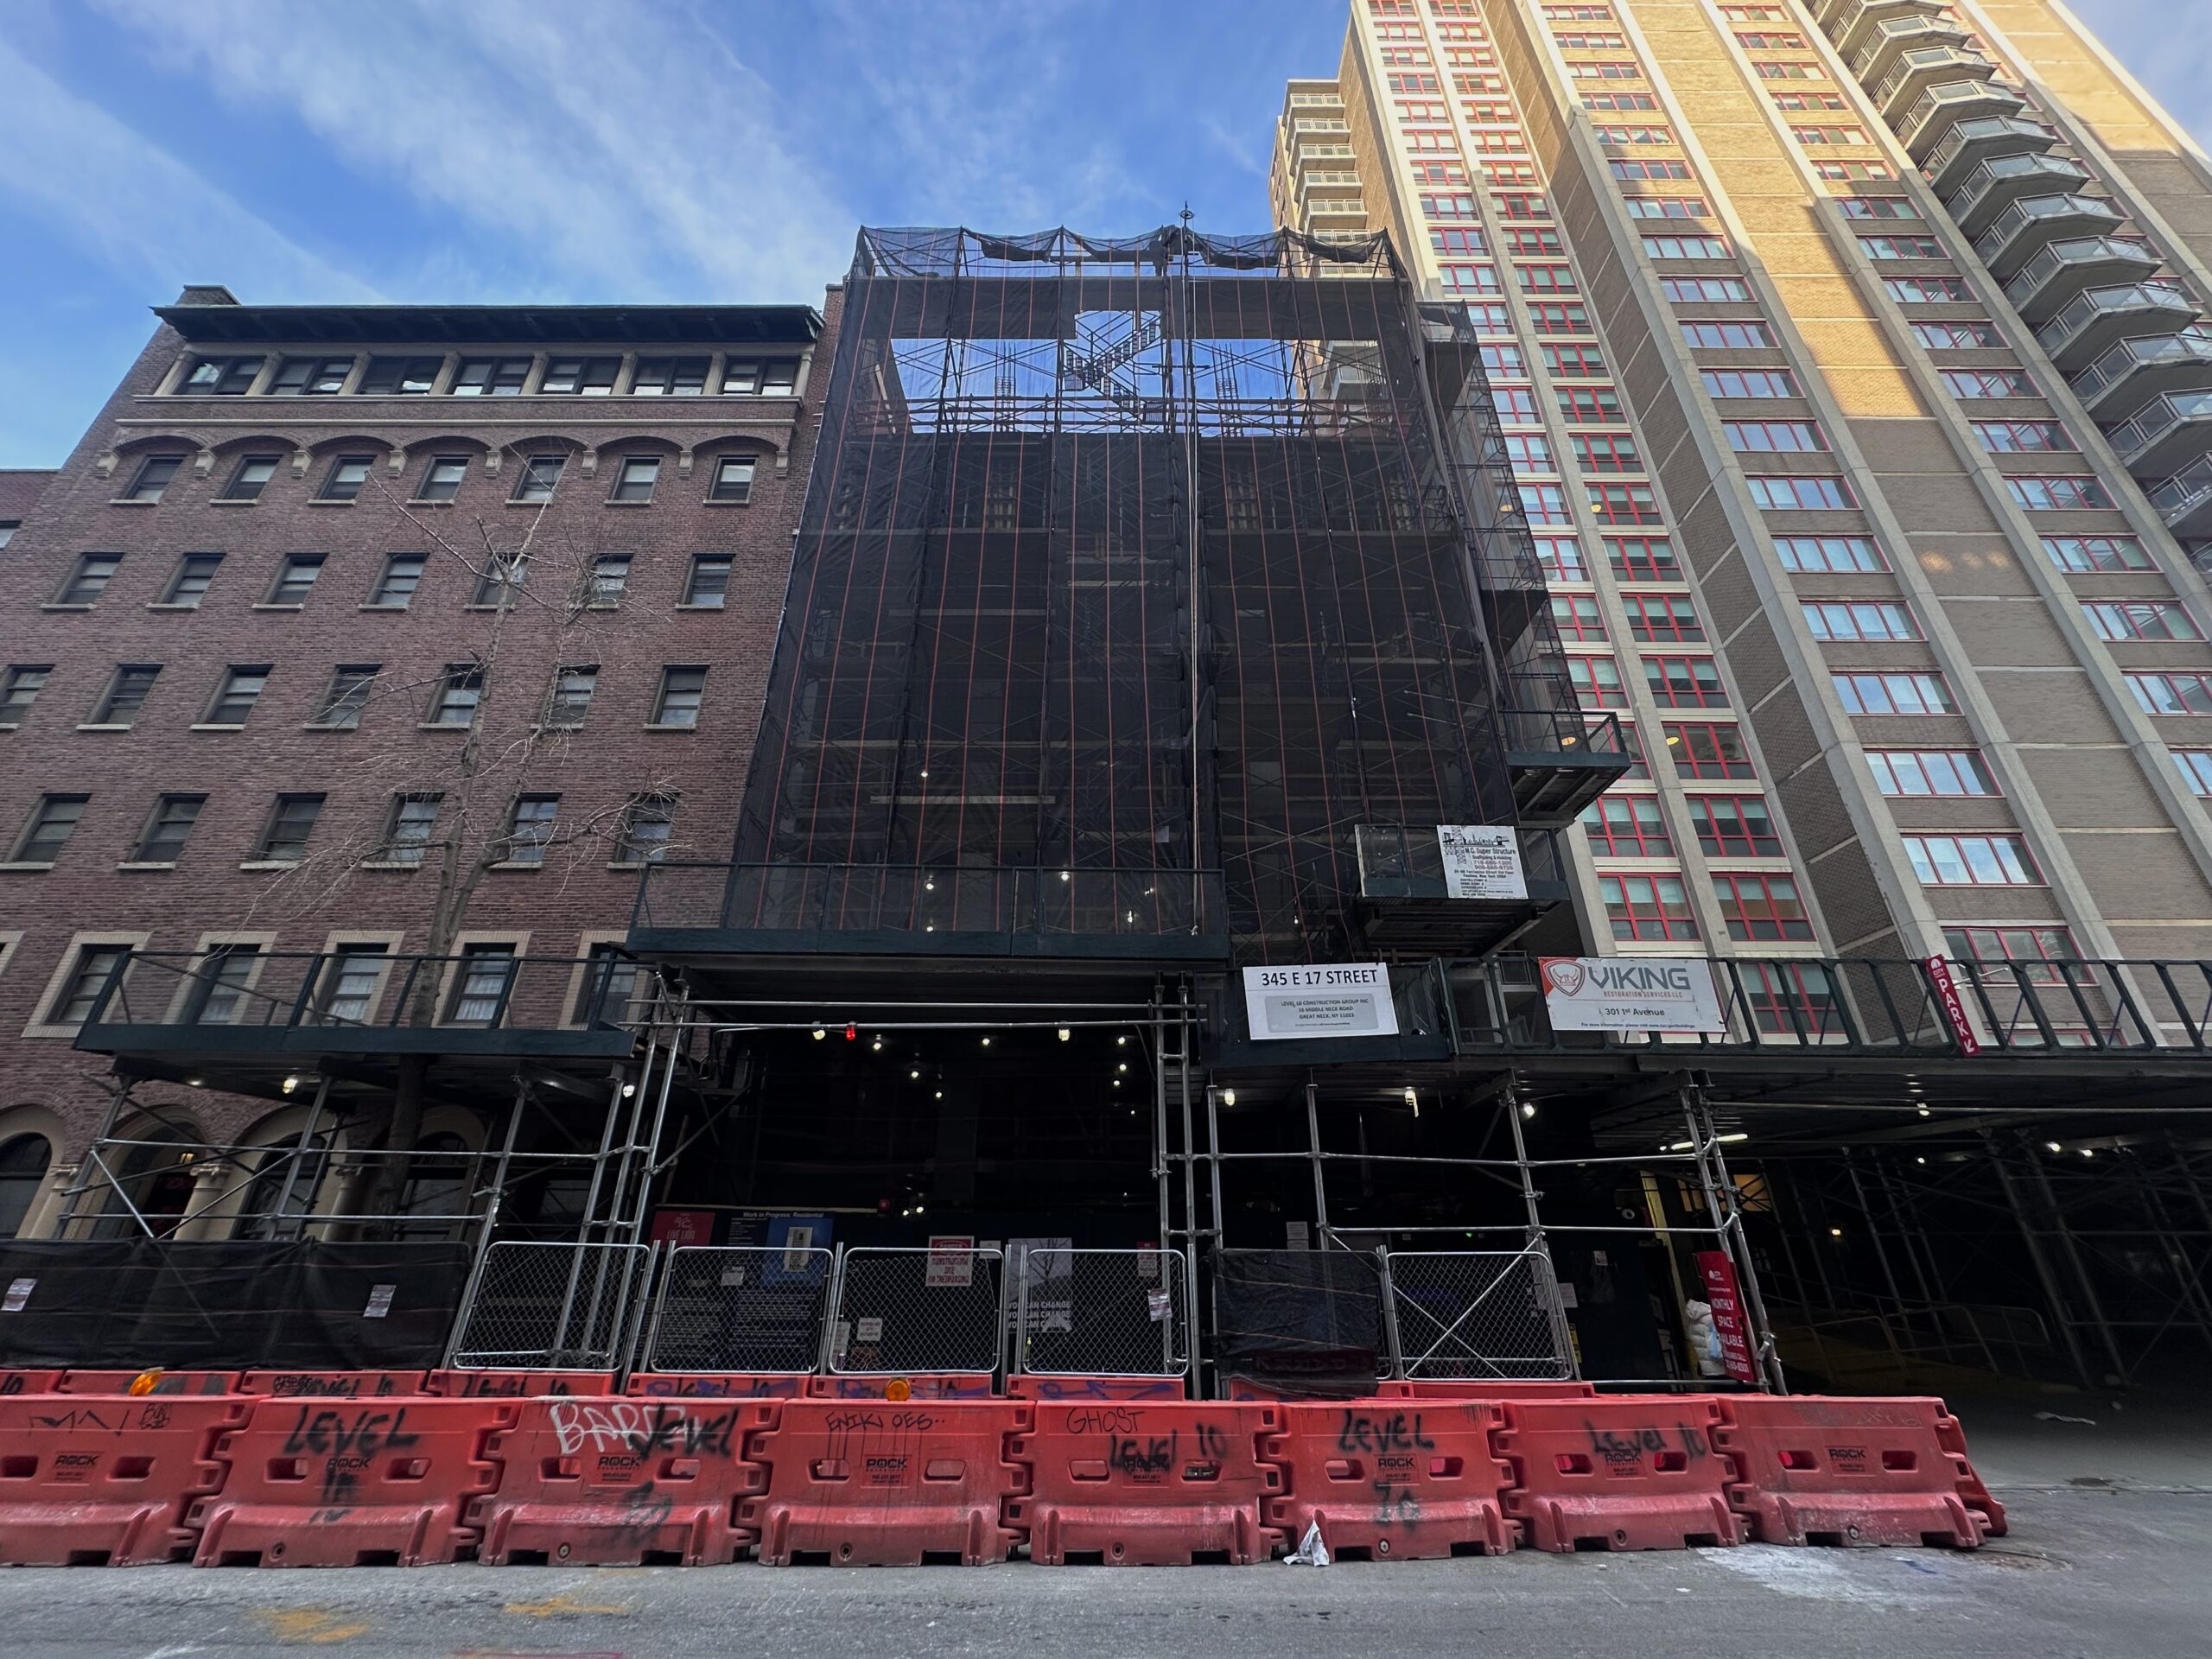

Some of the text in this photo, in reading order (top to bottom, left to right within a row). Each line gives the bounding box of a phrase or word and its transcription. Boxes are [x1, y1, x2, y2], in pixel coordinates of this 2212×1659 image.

[1262, 969, 1377, 986] 345 E 17 STREET
[1588, 967, 1691, 990] VIKING
[1633, 1007, 1665, 1016] Avenue
[1938, 978, 1968, 1036] PARK
[1718, 1315, 1734, 1329] SPACE
[1067, 1407, 1145, 1434] GHOST
[284, 1404, 419, 1458] LEVEL
[1340, 1408, 1434, 1452] LEVEL
[1605, 1452, 1640, 1462] ROCK
[1828, 1448, 1866, 1459] ROCK
[54, 1454, 99, 1465] ROCK
[326, 1458, 372, 1469] ROCK
[598, 1456, 640, 1467] ROCK
[867, 1458, 907, 1468] ROCK
[1378, 1457, 1414, 1467] ROCK
